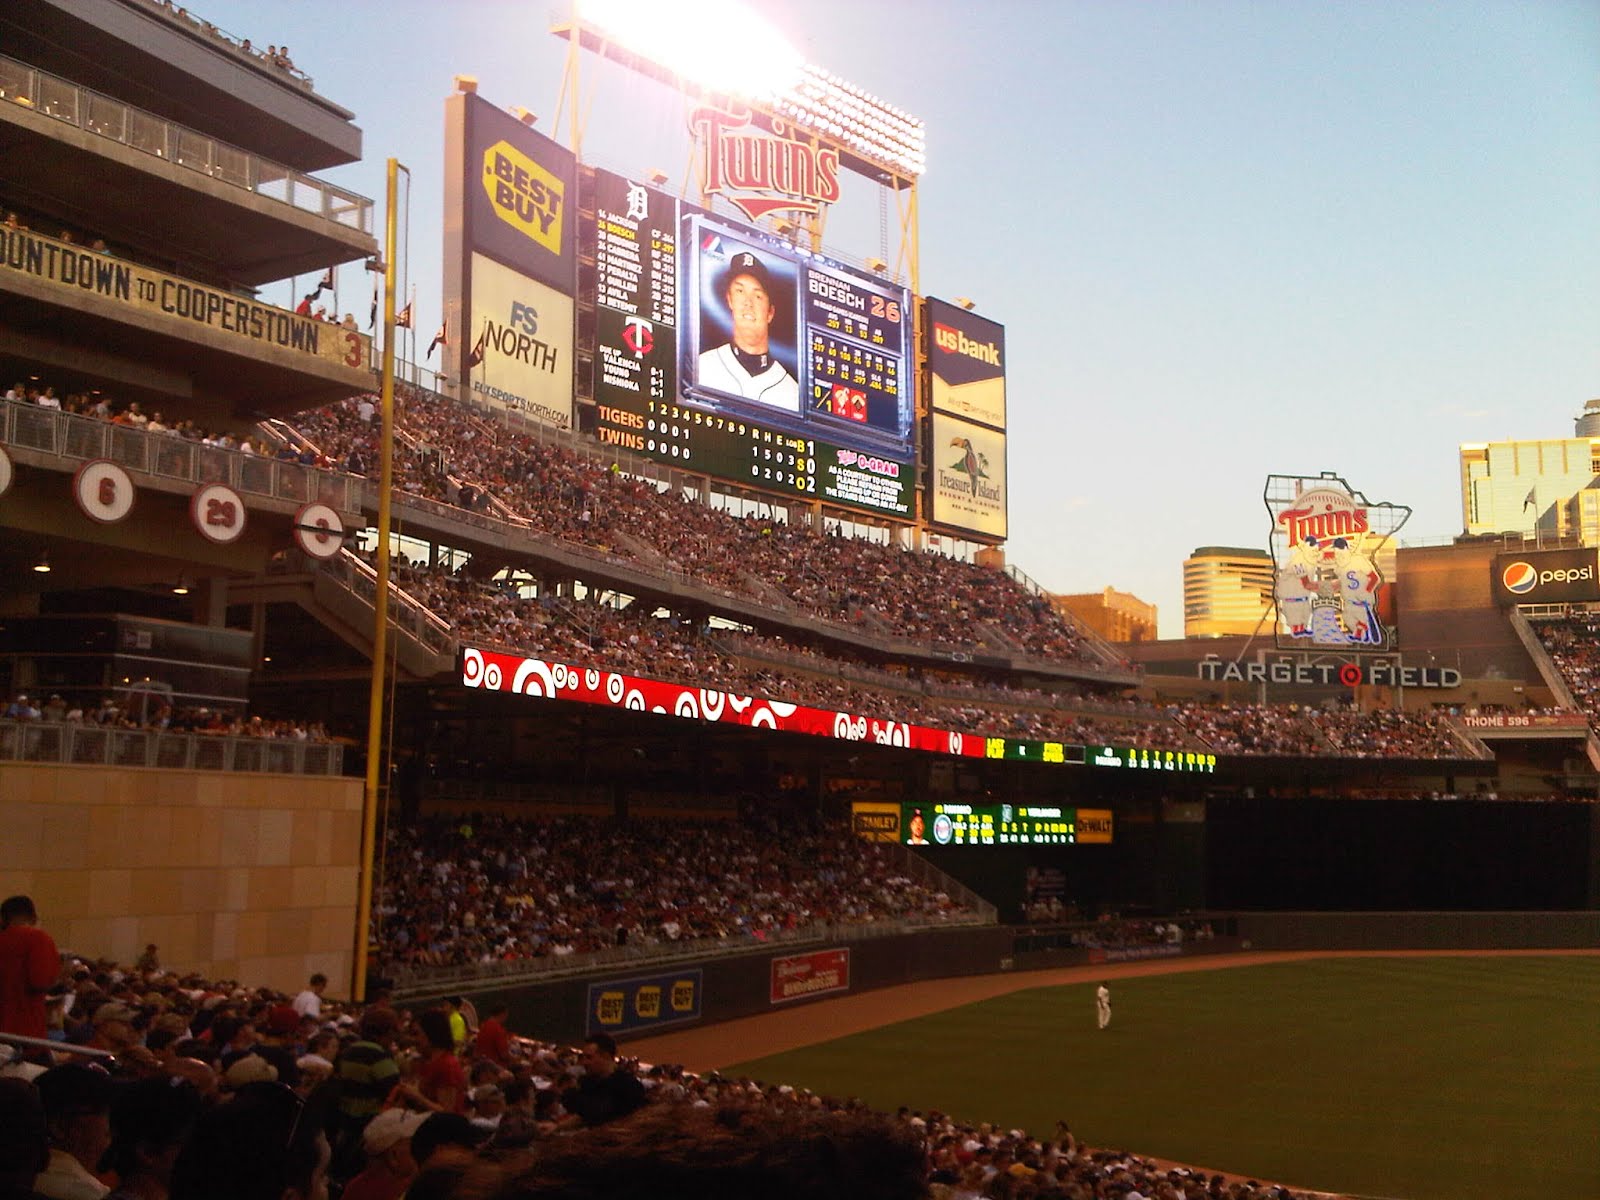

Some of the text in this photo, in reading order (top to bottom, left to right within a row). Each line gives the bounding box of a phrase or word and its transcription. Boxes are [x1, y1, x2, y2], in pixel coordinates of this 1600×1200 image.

[688, 105, 840, 204] Twins
[495, 151, 562, 214] BEST
[495, 179, 555, 235] BUY
[607, 223, 635, 240] BOESCH
[652, 240, 661, 249] LF
[607, 287, 628, 300] AVILA
[653, 302, 660, 310] C
[809, 279, 864, 310] BOESCH
[871, 296, 900, 323] 26
[138, 278, 156, 302] TO
[161, 280, 319, 355] COOPERSTOWN
[344, 332, 362, 368] 3
[510, 301, 538, 335] FS
[486, 320, 558, 374] NORTH
[604, 354, 640, 372] VALENCIA
[604, 363, 630, 378] YOUNG
[604, 374, 640, 392] NISHIOKA
[599, 405, 795, 466] TIGERS 0 0 0 1 1 5 0 3
[649, 401, 655, 412] 1
[660, 404, 668, 415] 2
[672, 406, 679, 418] 3
[683, 410, 690, 421] 4
[694, 413, 702, 424] 5
[706, 416, 713, 427] 6
[717, 418, 724, 430] 7
[728, 421, 735, 432] 8
[738, 424, 746, 436] 9
[752, 428, 760, 440] R
[764, 432, 772, 442] H
[776, 434, 783, 446] E
[598, 427, 795, 484] TWINS 0 0 0 0 0 2 0 2
[797, 440, 814, 456] B 1
[806, 458, 816, 474] 0
[99, 477, 116, 506] 6
[806, 476, 816, 492] 2
[938, 470, 1000, 502] Treasure Island
[206, 498, 237, 528] 29
[1278, 504, 1370, 548] Twins
[1347, 571, 1360, 590] S
[1540, 564, 1593, 585] pepsi
[1198, 661, 1462, 688] TARGET FIELD
[1464, 716, 1530, 726] THOME 596
